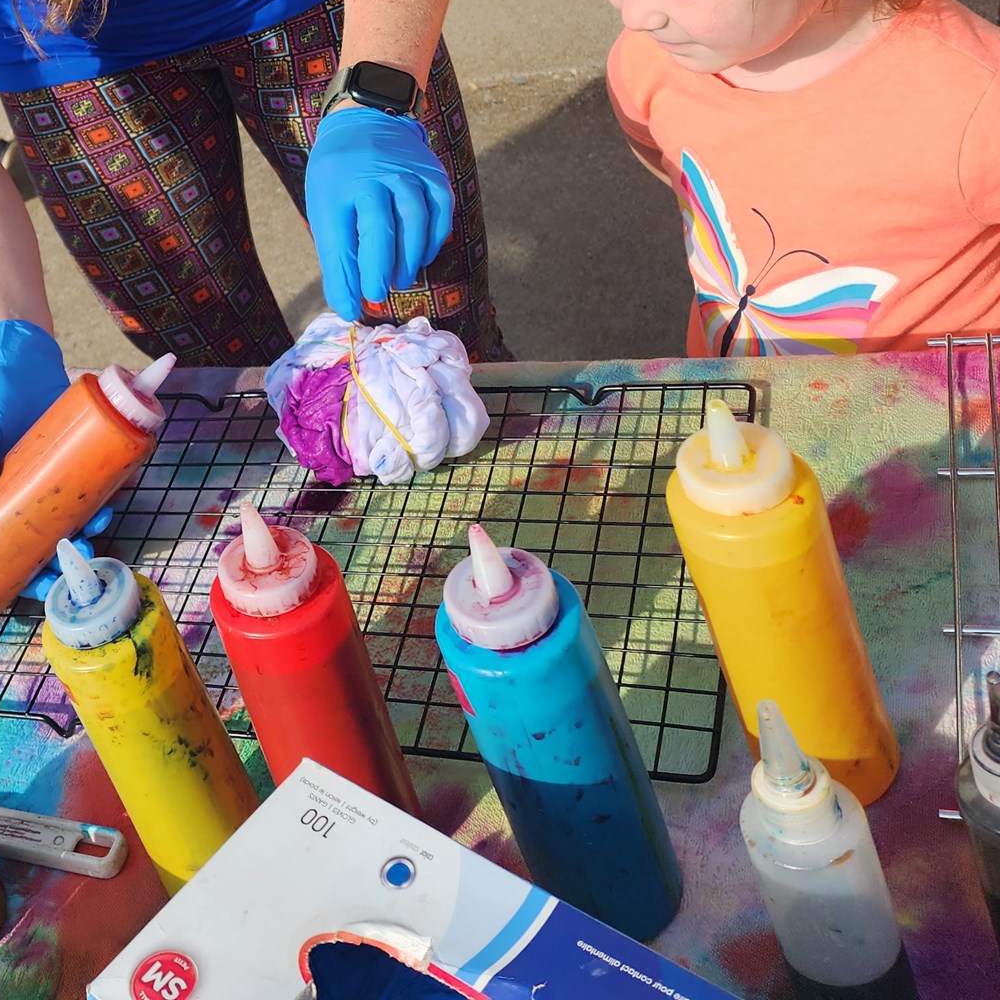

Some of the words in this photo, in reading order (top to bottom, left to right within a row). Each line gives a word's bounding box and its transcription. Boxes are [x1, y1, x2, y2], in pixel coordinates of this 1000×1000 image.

[307, 793, 327, 807] GANTS
[300, 808, 336, 839] 100
[330, 806, 356, 824] GLOVES
[576, 940, 621, 967] alimentaire
[141, 961, 188, 1000] SM
[620, 964, 652, 985] contact
[651, 979, 674, 996] pour
